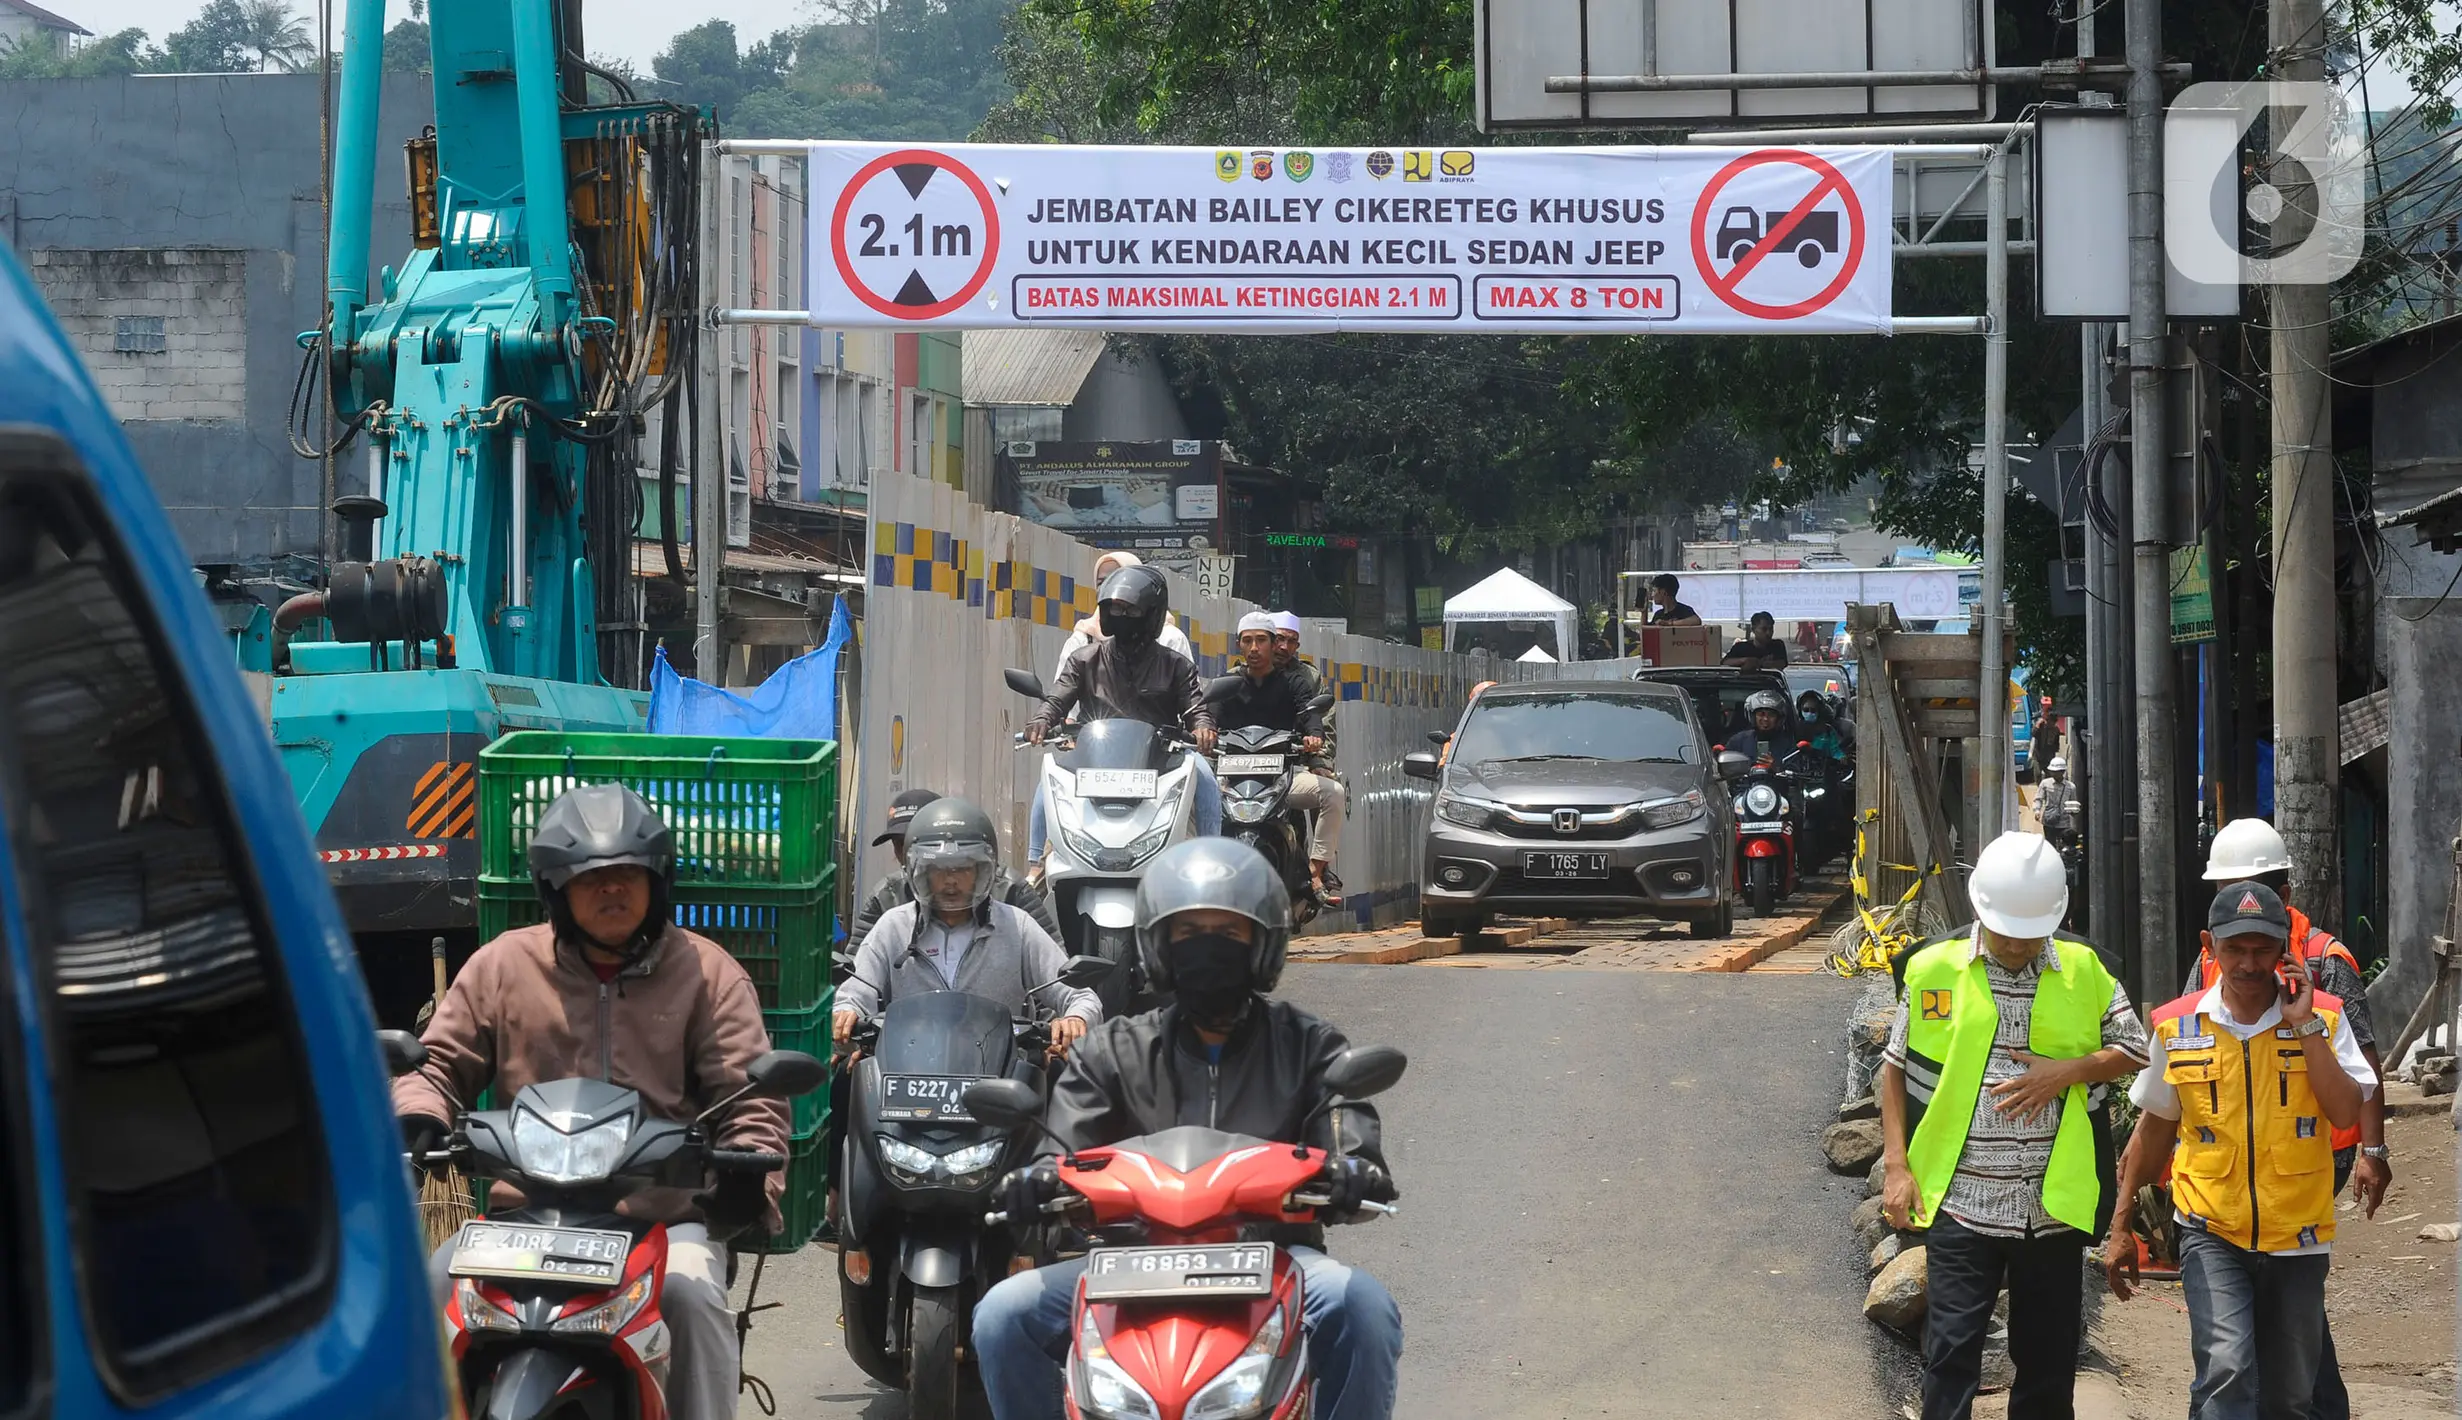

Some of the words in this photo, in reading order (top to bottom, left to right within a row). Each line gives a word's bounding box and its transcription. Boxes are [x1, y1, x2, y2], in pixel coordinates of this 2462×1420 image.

[1027, 198, 1197, 224] JEMBATAN
[1209, 198, 1324, 223] BAILEY
[1334, 198, 1518, 223] CIKERETEG
[1530, 198, 1665, 224] KHUSUS
[859, 213, 971, 257] 2.1m
[1028, 239, 1141, 265] UNTUK
[1151, 239, 1350, 265] KENDARAAN
[1362, 239, 1457, 265] KECIL
[1467, 239, 1573, 265] SEDAN
[1584, 240, 1665, 266] JEEP
[1028, 287, 1100, 308] BATAS
[1107, 287, 1229, 308] MAKSIMAL
[1236, 287, 1380, 308] KETINGGIAN
[1388, 287, 1419, 307] 2.1
[1429, 287, 1447, 307] M
[1491, 286, 1560, 308] MAX
[1570, 287, 1588, 309] 8
[1598, 287, 1663, 309] TON
[1085, 461, 1152, 469] ALHARAMAIN
[1080, 771, 1087, 782] F
[1526, 854, 1535, 869] F
[1549, 854, 1579, 870] 1765
[1591, 855, 1607, 870] LY
[887, 1079, 898, 1097] F
[907, 1079, 949, 1098] 6227
[467, 1230, 485, 1248] F
[496, 1231, 557, 1253] 4084
[573, 1239, 620, 1259] FFC
[1101, 1257, 1117, 1275] F
[1141, 1253, 1208, 1272] 6953
[1229, 1251, 1262, 1270] TF
